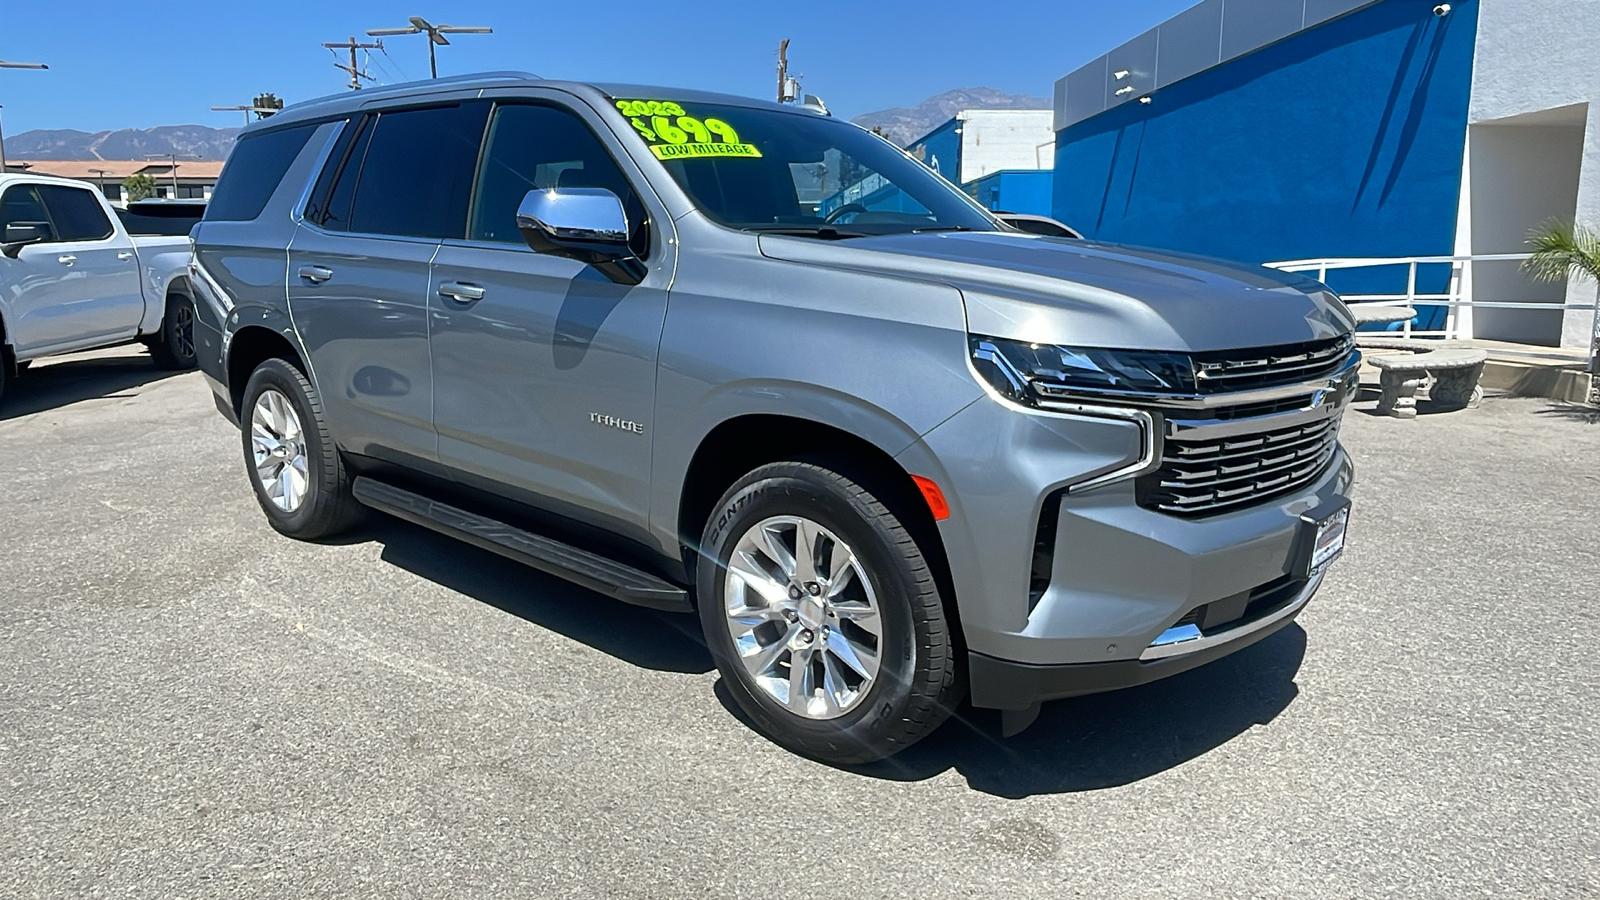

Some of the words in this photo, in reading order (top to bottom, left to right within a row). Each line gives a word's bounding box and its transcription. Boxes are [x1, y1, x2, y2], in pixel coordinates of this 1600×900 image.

[659, 145, 692, 157] LOW
[694, 144, 753, 156] MILEAGE
[588, 412, 643, 434] TAHOE
